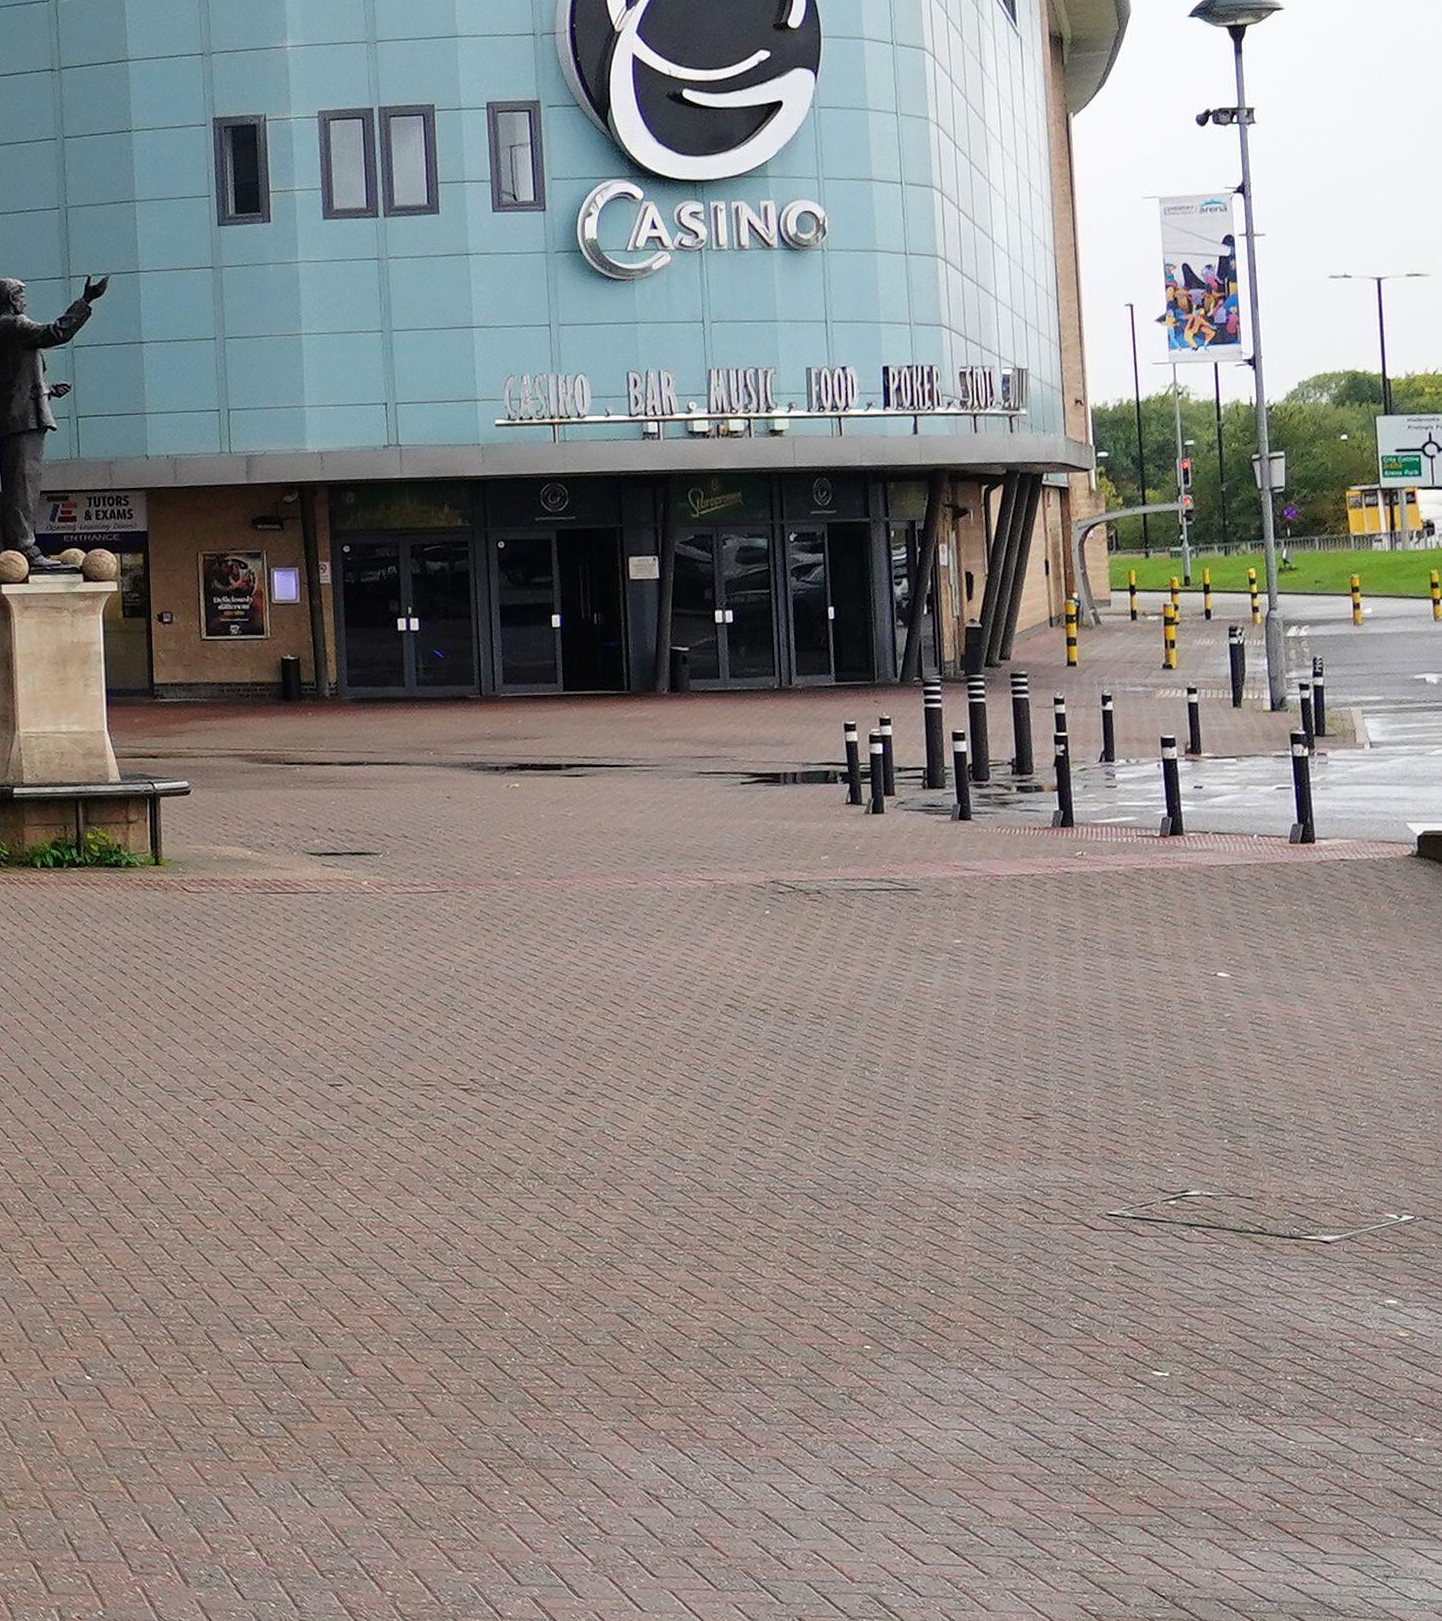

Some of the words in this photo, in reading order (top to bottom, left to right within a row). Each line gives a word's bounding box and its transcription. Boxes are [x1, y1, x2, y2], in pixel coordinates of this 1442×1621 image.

[576, 179, 827, 280] CASINO
[504, 372, 592, 418] CASINO
[627, 370, 677, 417] BAR
[707, 368, 776, 415] MUSIC
[805, 366, 857, 413] FOOD
[882, 365, 941, 412] POKER
[84, 509, 93, 521] &
[95, 508, 134, 521] EXAMS
[86, 495, 130, 508] TUTORS
